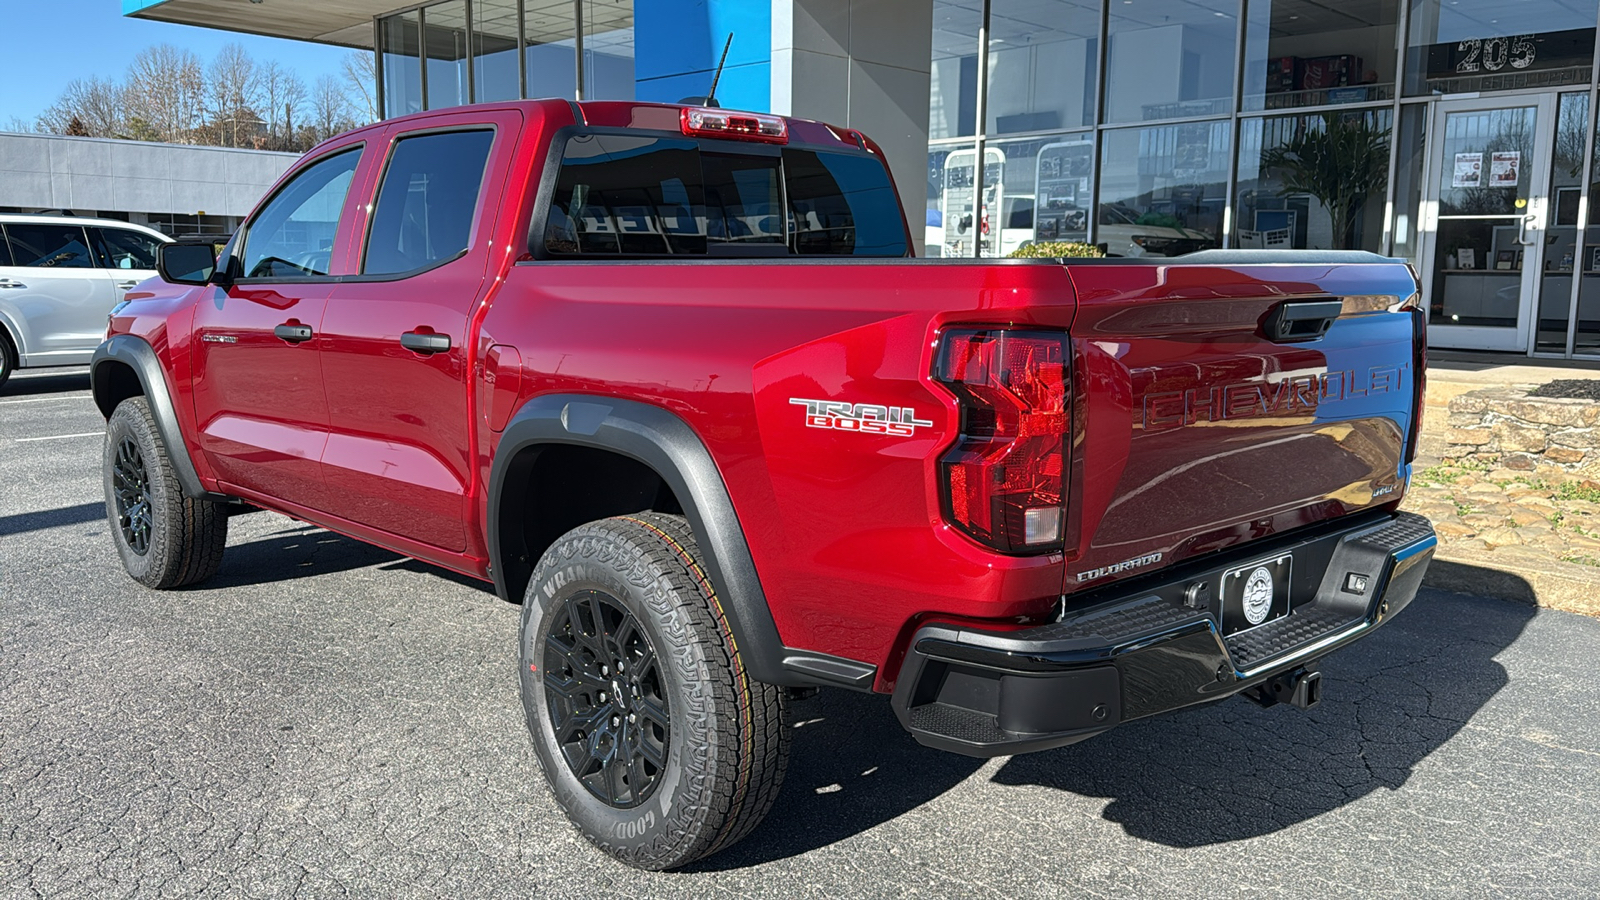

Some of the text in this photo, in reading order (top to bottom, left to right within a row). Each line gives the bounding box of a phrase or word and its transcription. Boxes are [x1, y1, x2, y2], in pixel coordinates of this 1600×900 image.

[1456, 34, 1536, 73] 205
[789, 398, 933, 428] TRAIL
[1143, 362, 1408, 430] CHEVROLET
[806, 415, 914, 437] BOSS
[543, 564, 632, 602] WRANGLER
[1077, 552, 1162, 581] COLORADO
